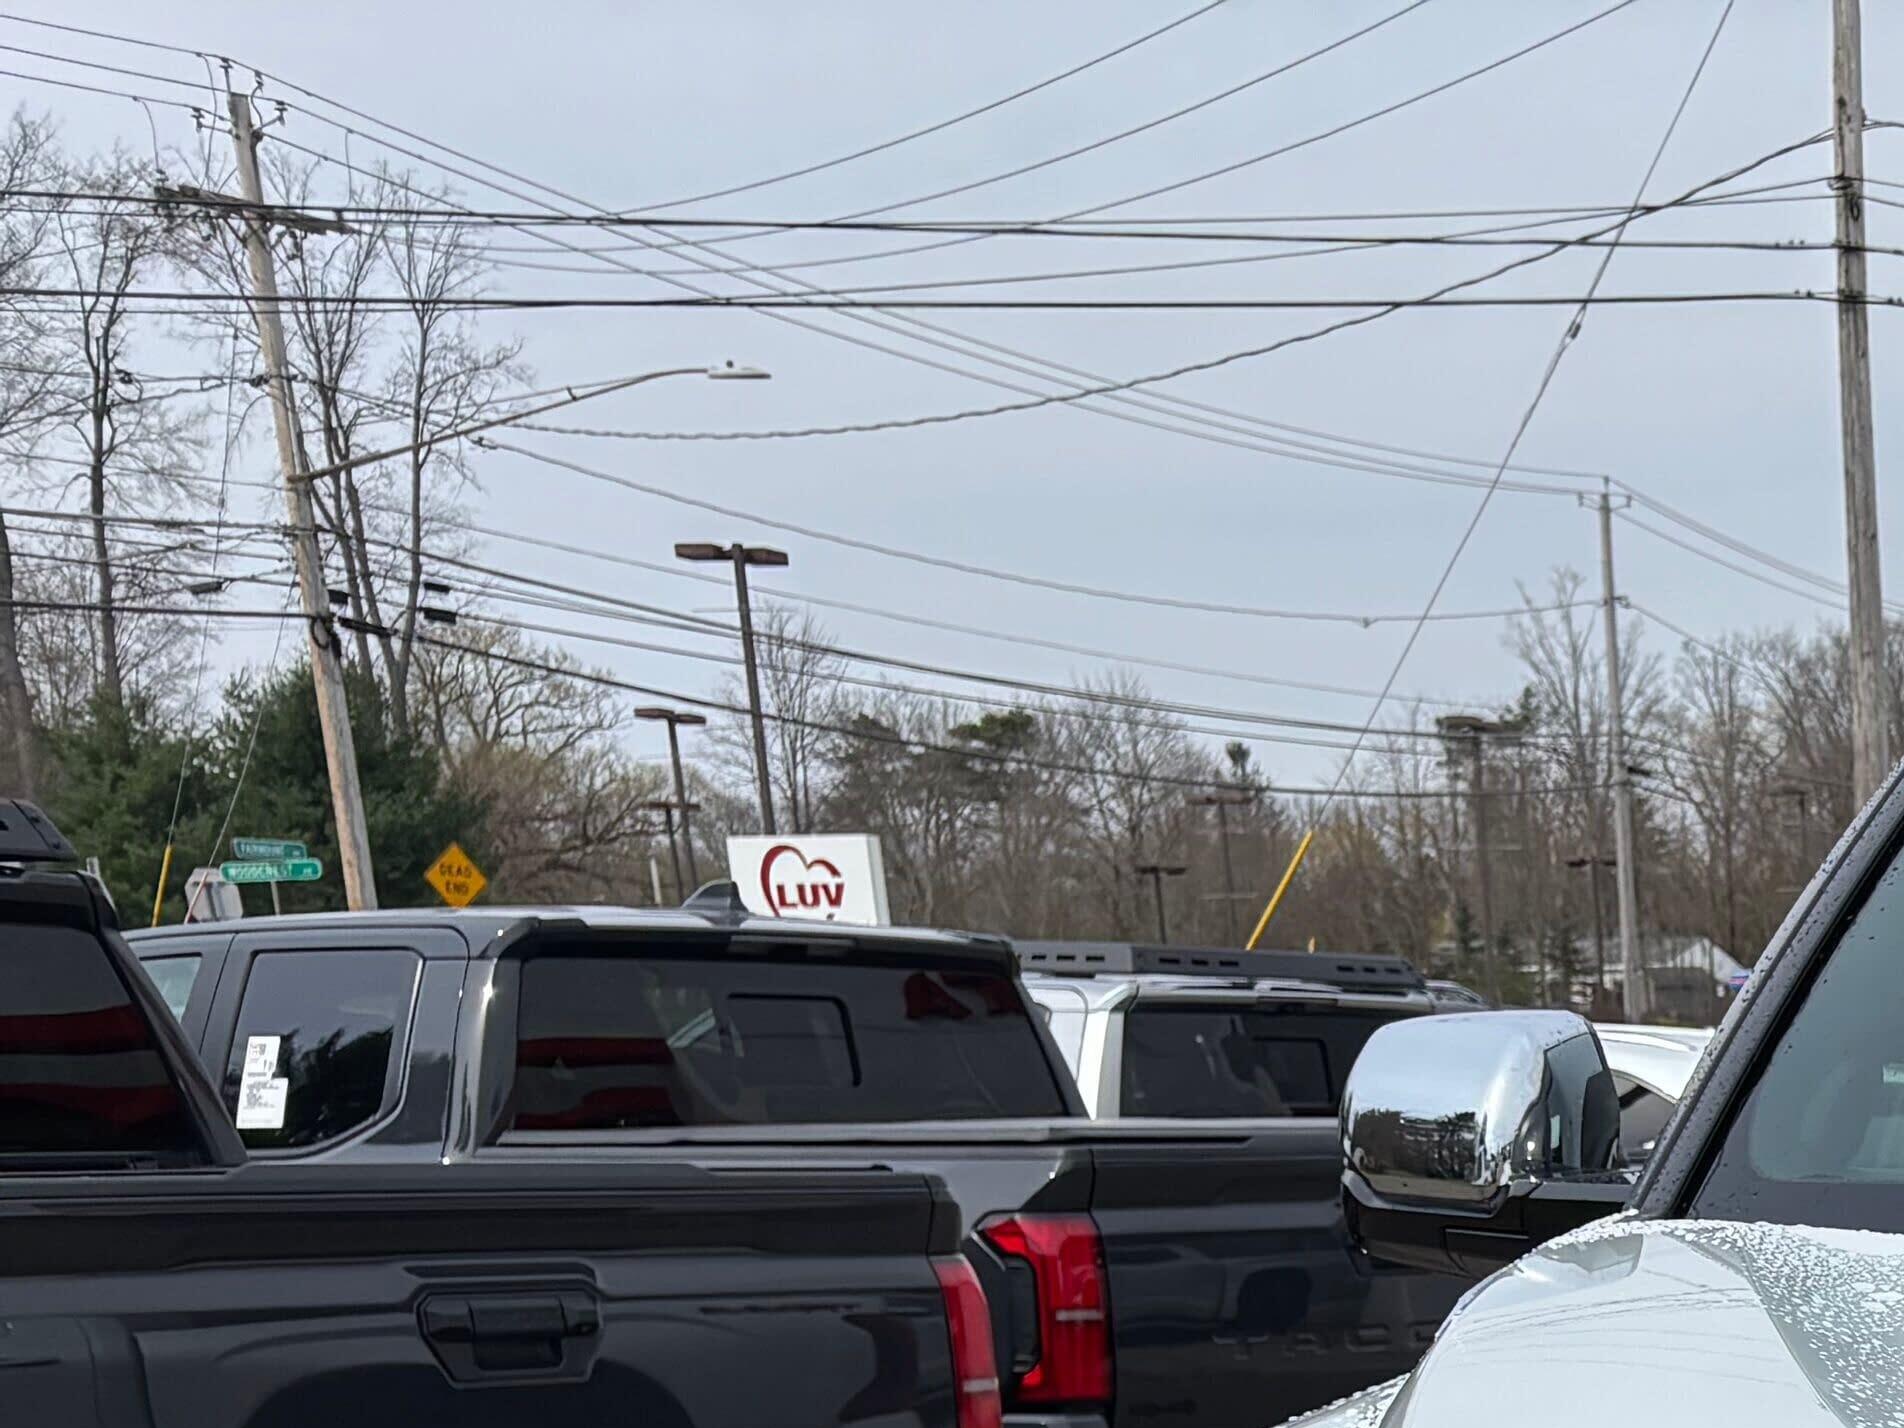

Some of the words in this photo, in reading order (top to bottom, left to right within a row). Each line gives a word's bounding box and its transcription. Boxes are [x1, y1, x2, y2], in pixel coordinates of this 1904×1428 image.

[438, 863, 473, 879] DEAD
[445, 880, 469, 897] END
[776, 882, 845, 909] LUV
